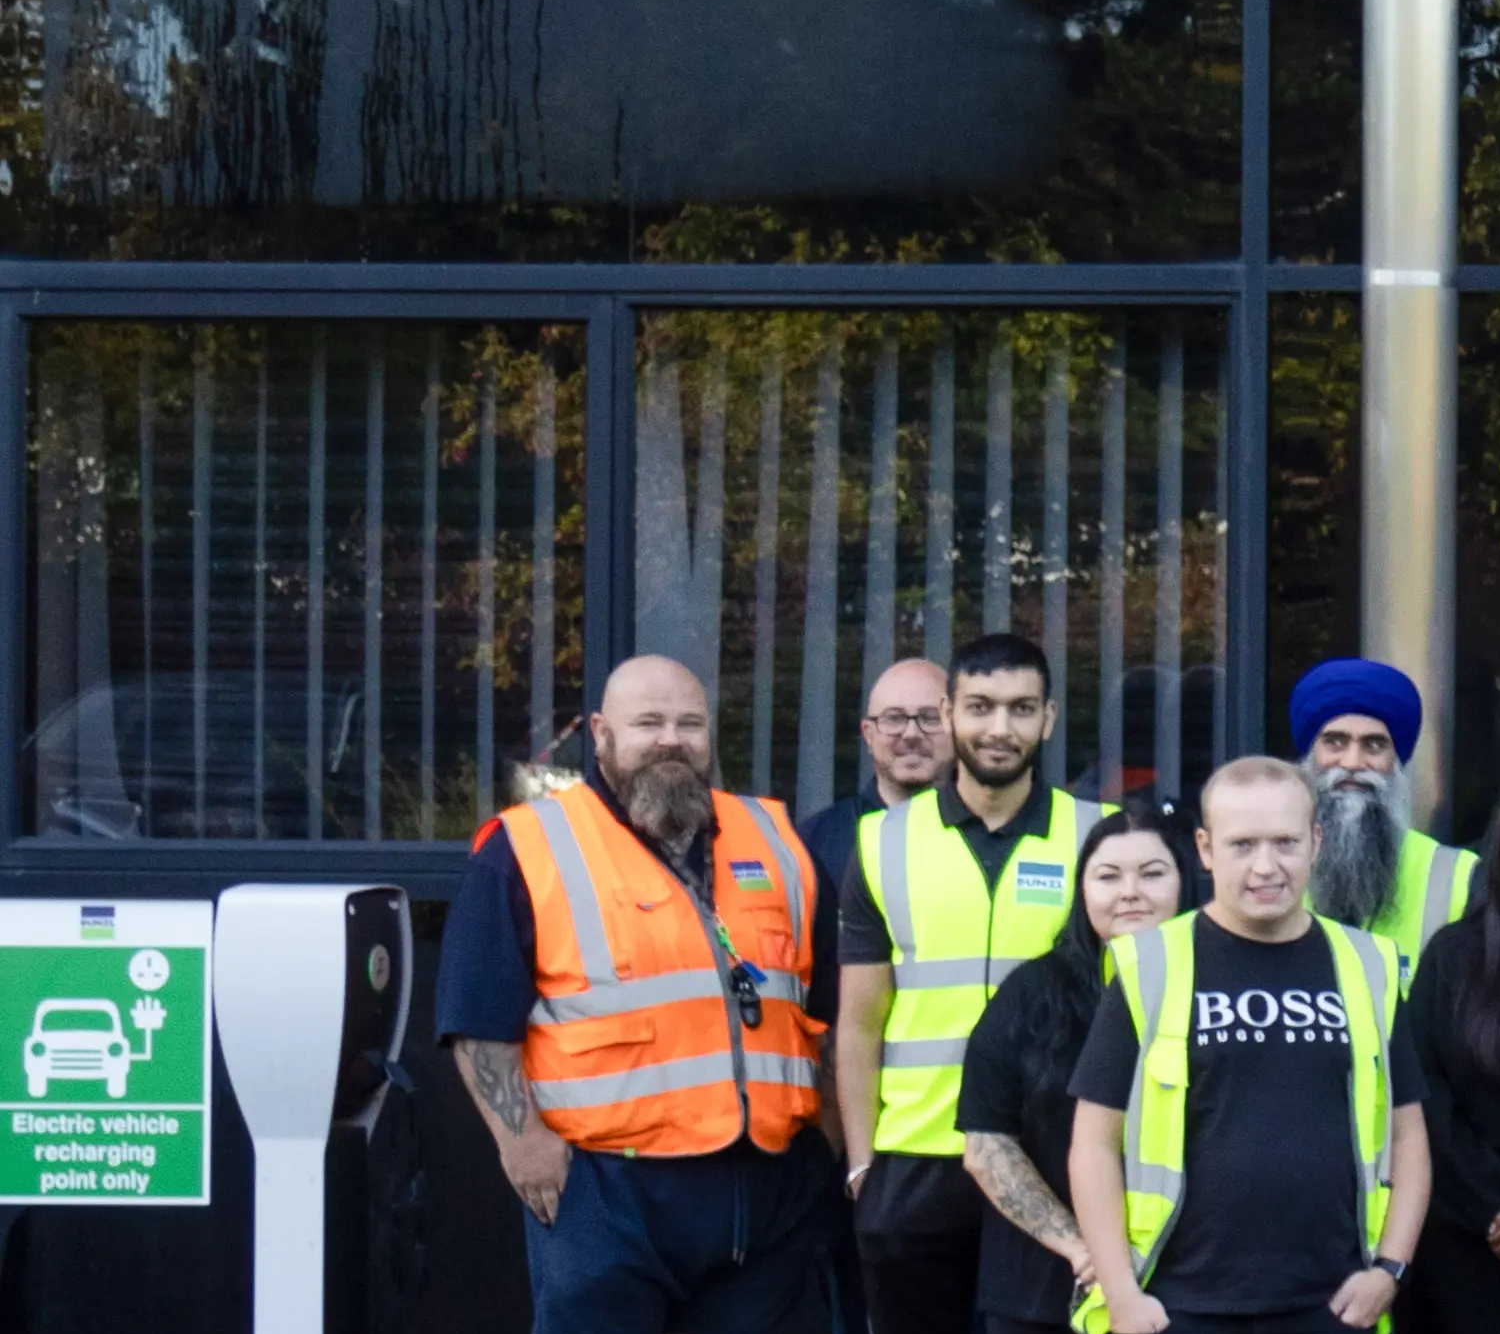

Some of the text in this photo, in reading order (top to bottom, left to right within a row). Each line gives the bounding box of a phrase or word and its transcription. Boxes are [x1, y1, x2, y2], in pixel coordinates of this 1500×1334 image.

[1195, 989, 1348, 1030] BOSS
[1197, 1028, 1266, 1047] HUGO
[12, 1112, 180, 1135] Electric vehicle
[34, 1141, 157, 1167] recharging
[40, 1169, 150, 1195] point only
